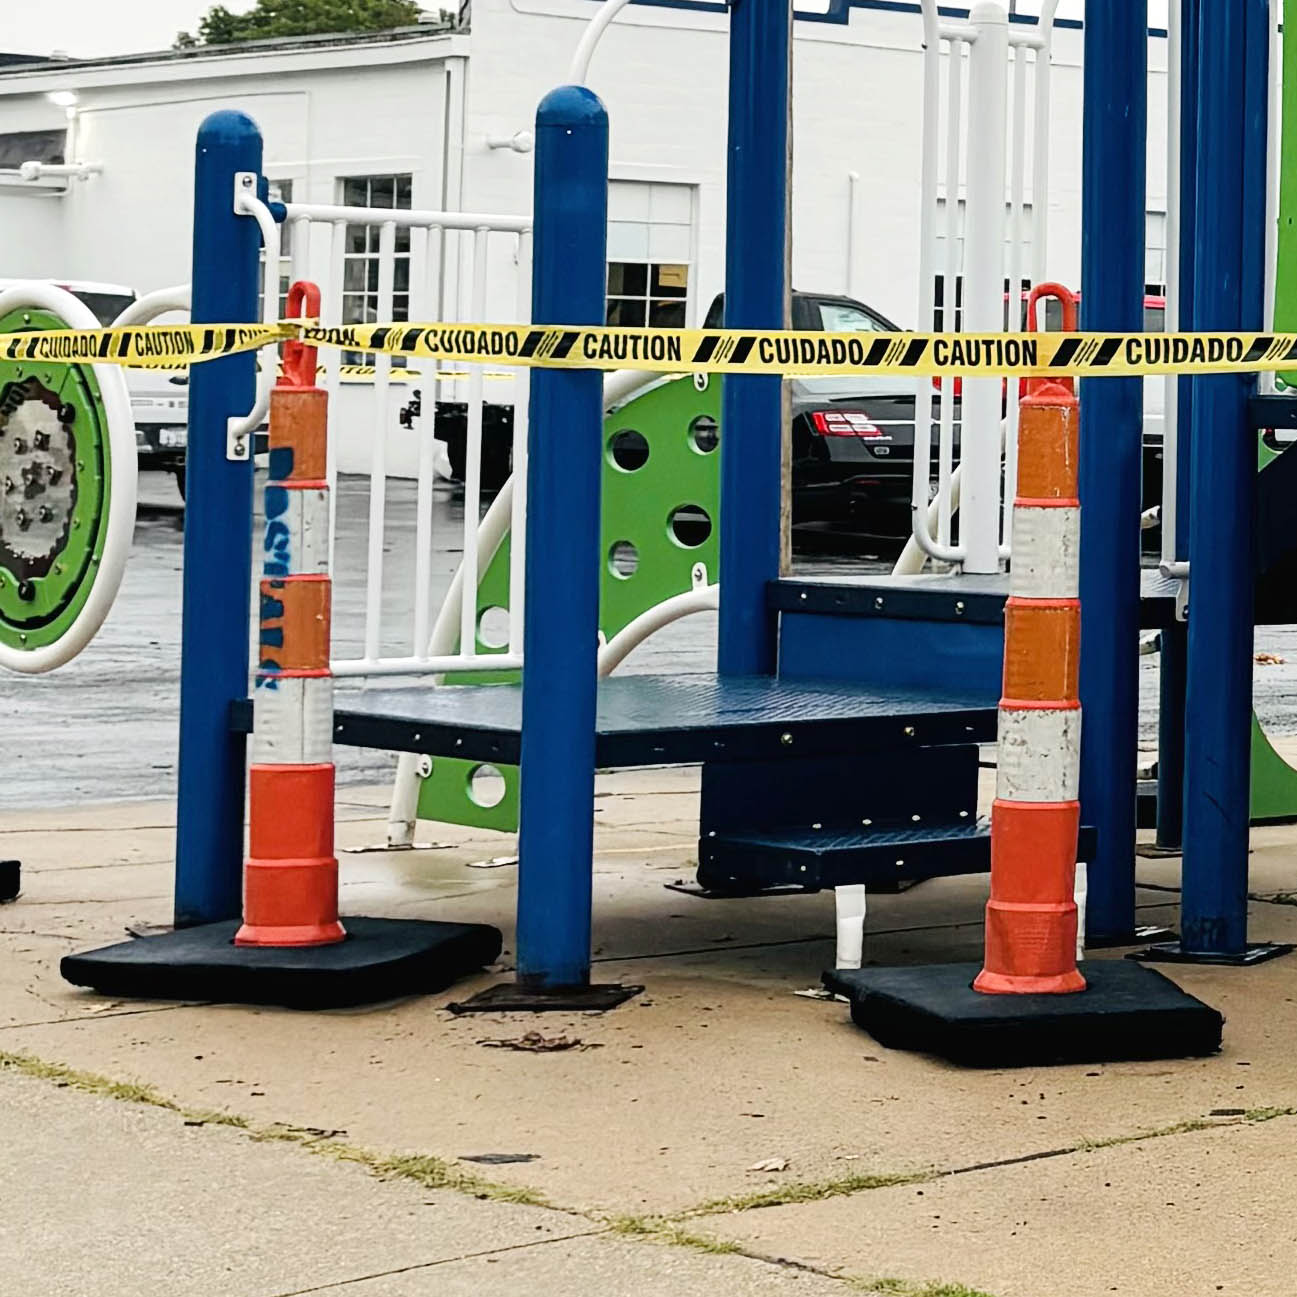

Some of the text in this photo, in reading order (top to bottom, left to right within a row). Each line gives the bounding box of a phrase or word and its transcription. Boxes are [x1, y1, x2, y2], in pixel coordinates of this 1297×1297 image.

[40, 331, 194, 358] CUIDADO CAUTION
[424, 329, 519, 357] CUIDADO
[583, 334, 682, 362] CAUTION
[758, 338, 864, 366] CUIDADO
[933, 339, 1037, 367] CAUTION
[1125, 337, 1243, 364] CUIDADO
